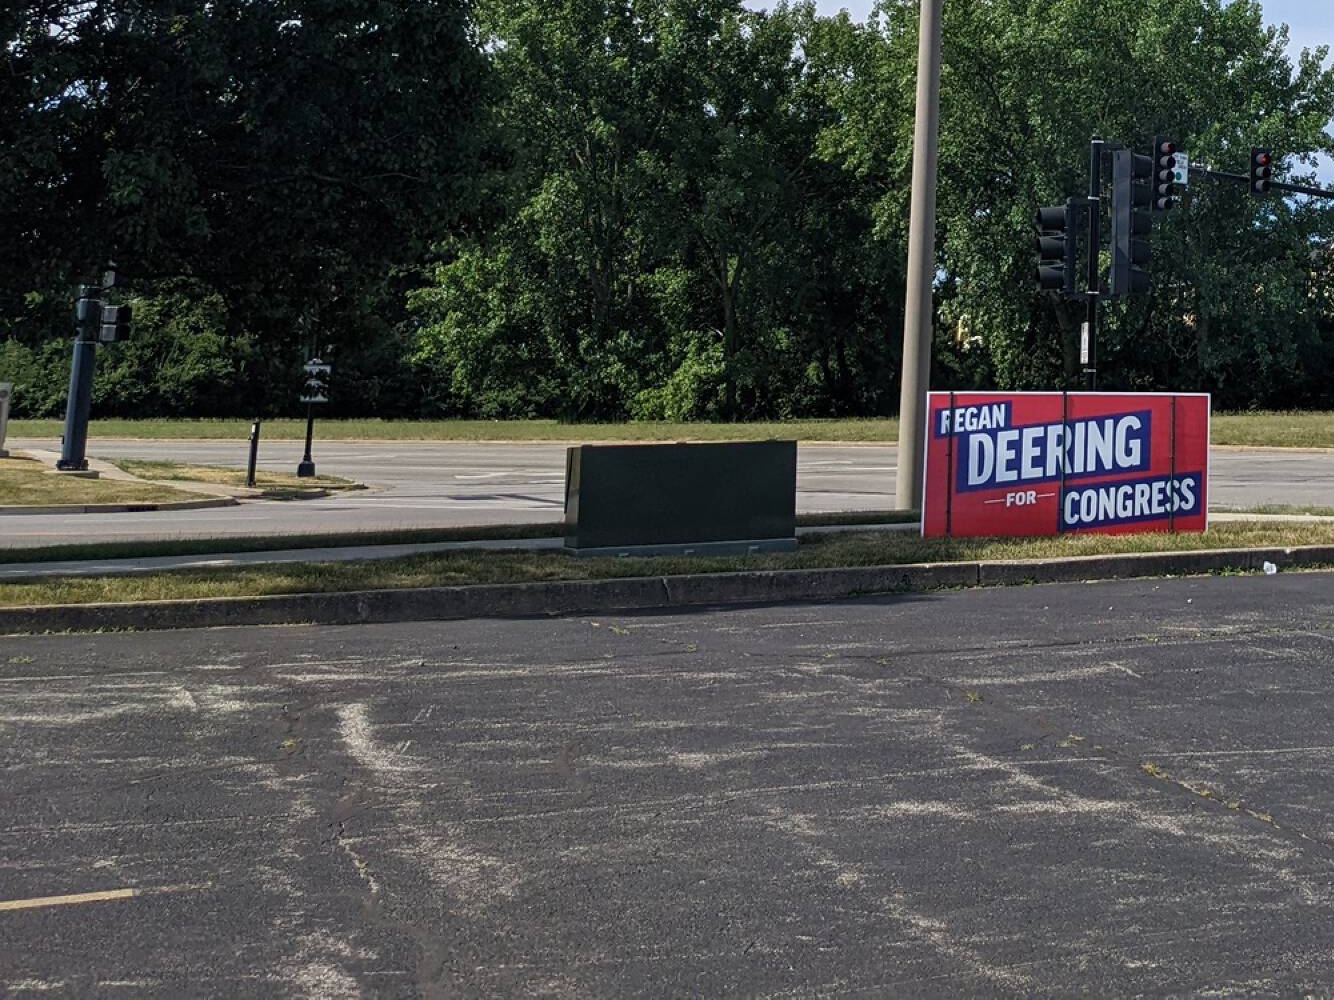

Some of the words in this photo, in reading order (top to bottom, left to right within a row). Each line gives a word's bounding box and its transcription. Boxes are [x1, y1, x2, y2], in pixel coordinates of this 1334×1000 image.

[940, 403, 1006, 435] REGAN
[967, 415, 1142, 486] DEERING
[1006, 490, 1036, 507] FOR
[1063, 477, 1196, 526] CONGRESS
